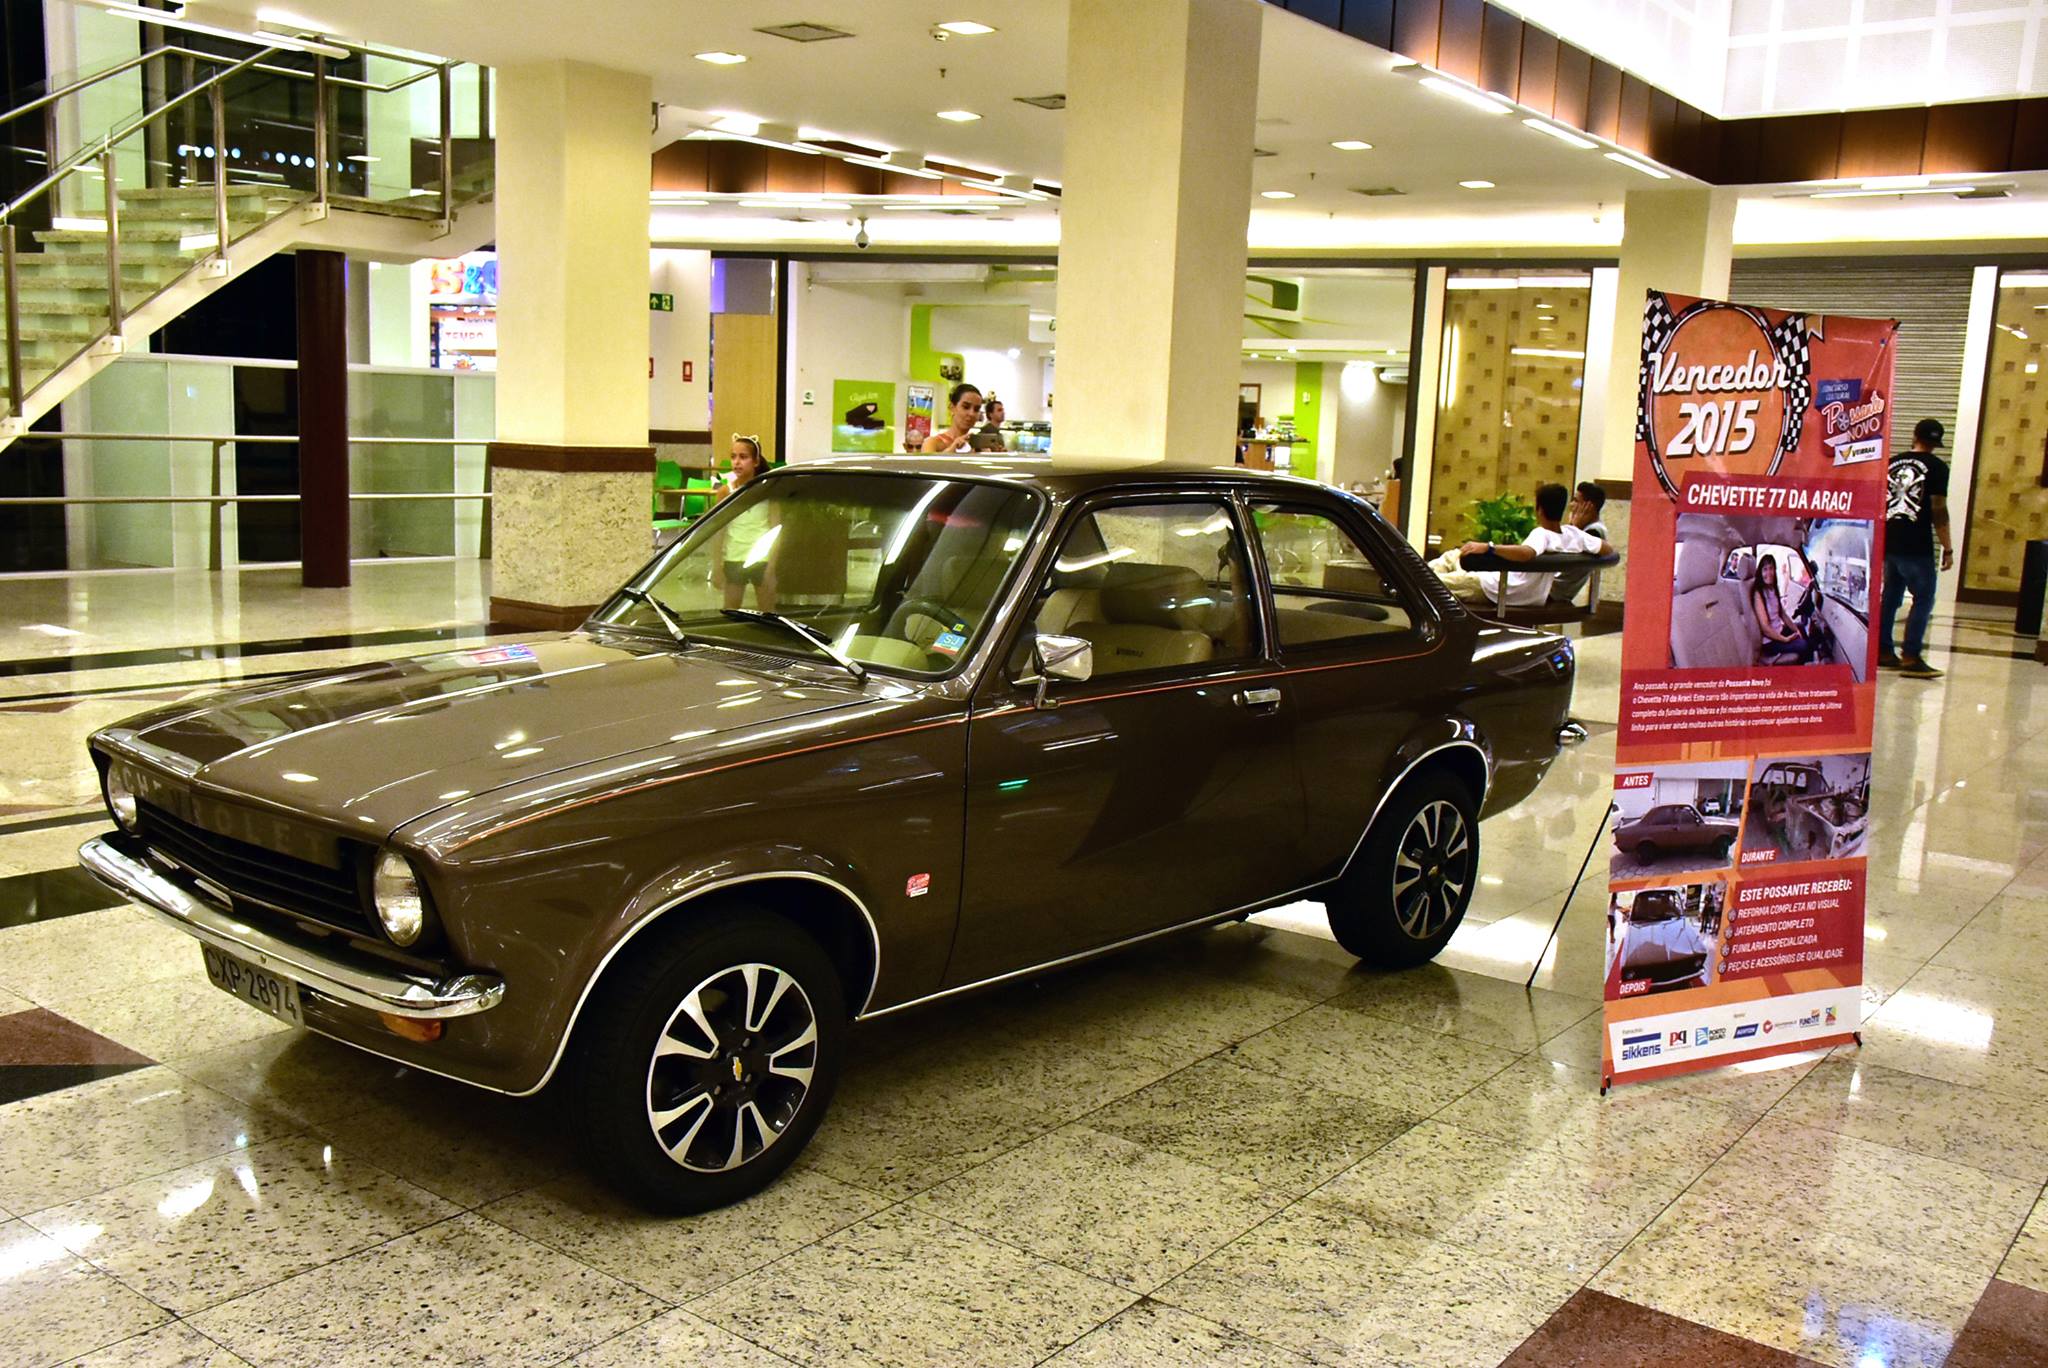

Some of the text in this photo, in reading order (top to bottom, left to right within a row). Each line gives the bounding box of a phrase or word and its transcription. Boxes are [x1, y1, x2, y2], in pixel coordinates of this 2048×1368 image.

[1648, 349, 1791, 393] Vencedor
[1666, 399, 1760, 456] 2015
[1847, 417, 1880, 440] NOVO
[1687, 483, 1853, 511] CHEVETTE 77 DA ARACI
[1622, 775, 1649, 787] ANTES
[1741, 850, 1776, 863] DURANTE
[1740, 879, 1853, 902] ESTE POSSANTE RECEBEU:
[1737, 898, 1839, 918] REFORMA COMPLETA NO VISUAL
[1734, 918, 1814, 936] JATEAMENTO COMPLETO
[1732, 934, 1818, 954] FUNILARIA ESPECIALIZADA
[1727, 948, 1844, 973] PEÇAS E ACESSÓRIOS DE QUALIDADE
[1619, 981, 1646, 994] DEPOIS
[1622, 1044, 1661, 1060] sikkens
